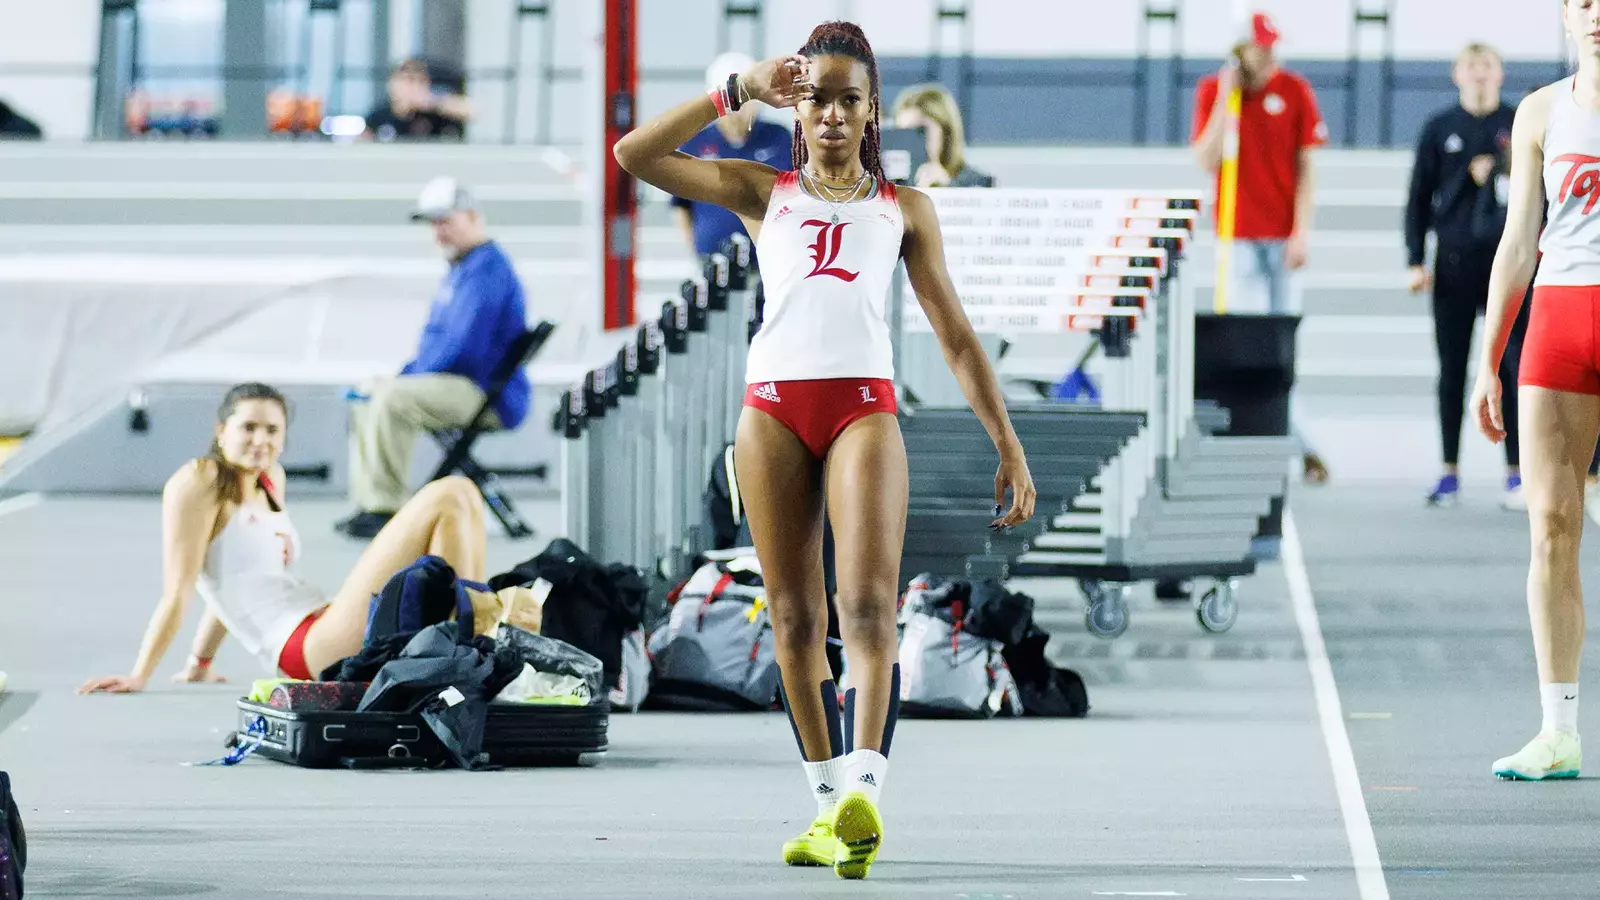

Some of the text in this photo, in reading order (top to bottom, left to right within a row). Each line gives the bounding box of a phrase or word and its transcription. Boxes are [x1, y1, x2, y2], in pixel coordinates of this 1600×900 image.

[800, 219, 860, 282] L
[753, 389, 781, 403] adidas
[857, 385, 877, 404] L
